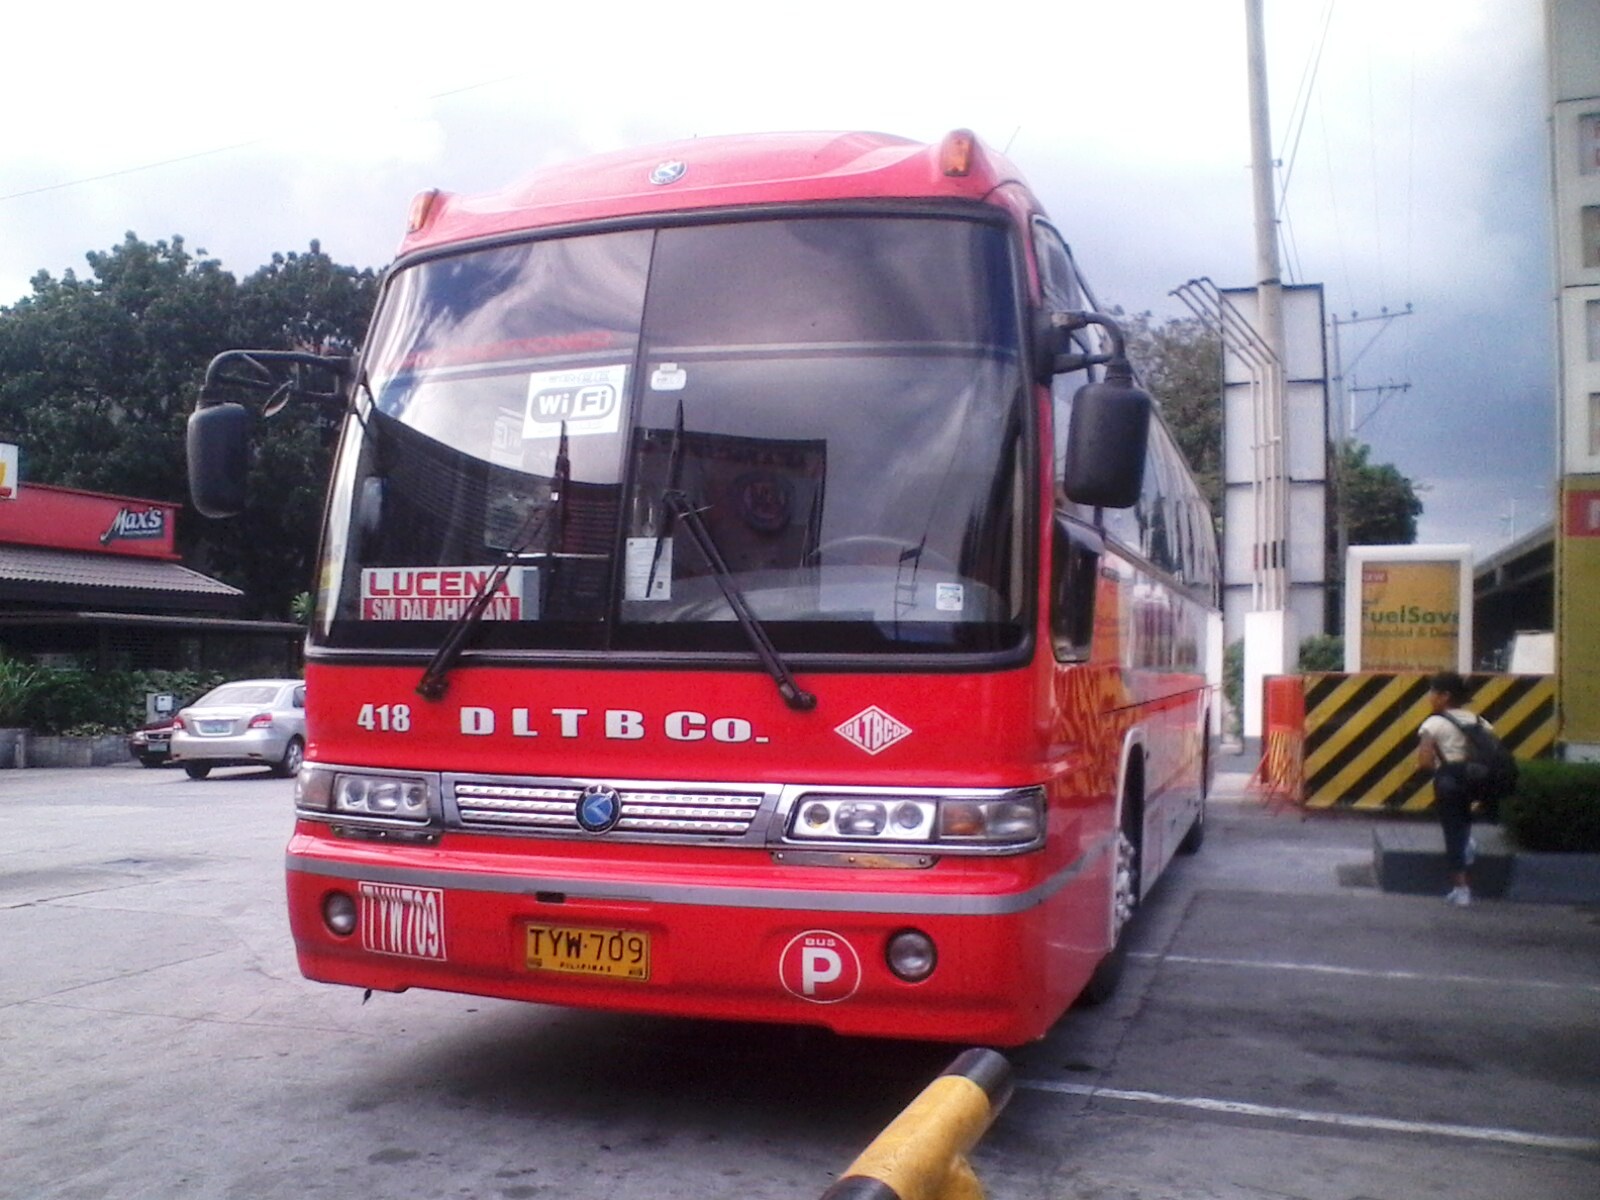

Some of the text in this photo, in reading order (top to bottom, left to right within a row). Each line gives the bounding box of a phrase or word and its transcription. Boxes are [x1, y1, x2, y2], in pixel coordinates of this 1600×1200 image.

[369, 571, 510, 597] LUCENA
[372, 598, 512, 621] SM DALAHIAN
[357, 704, 410, 731] 418
[362, 884, 439, 957] TYW709
[805, 938, 836, 947] BUS
[802, 946, 842, 995] P
